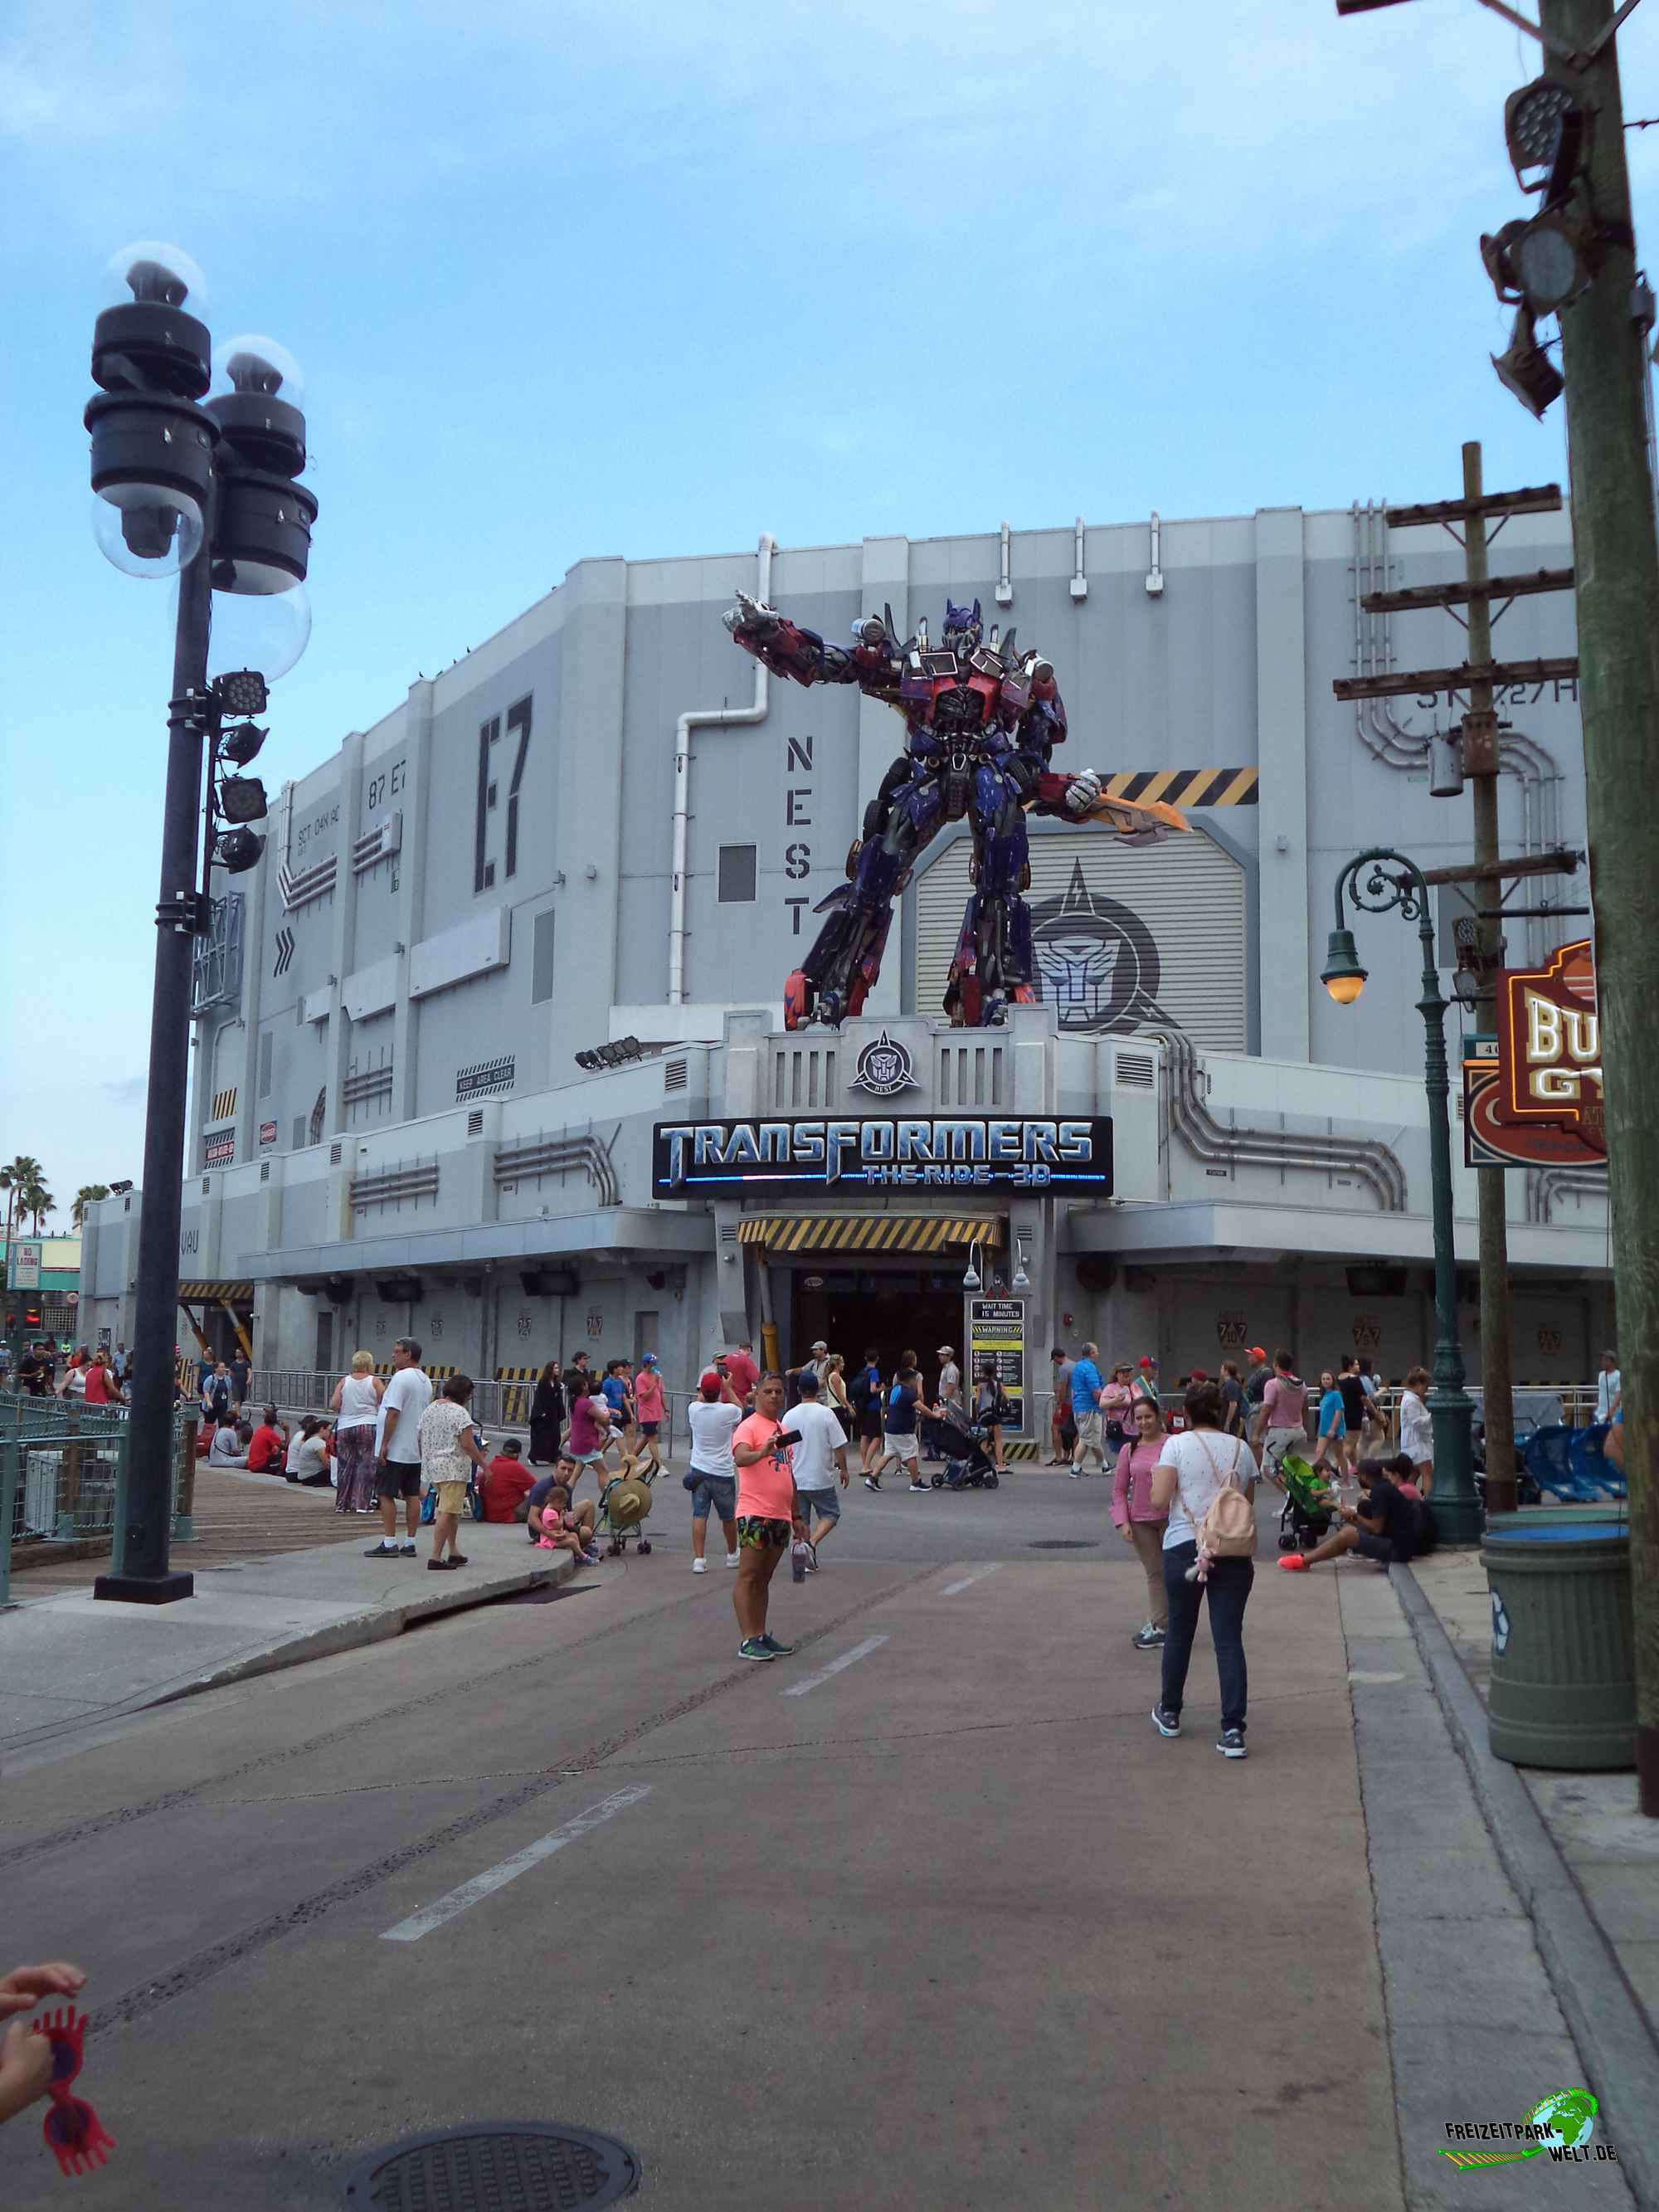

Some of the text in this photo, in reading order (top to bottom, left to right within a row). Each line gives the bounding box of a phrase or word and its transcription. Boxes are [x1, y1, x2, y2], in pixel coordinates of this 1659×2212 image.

[369, 774, 386, 810] 87
[474, 694, 533, 894] E7
[785, 737, 813, 934] NEST
[459, 1066, 512, 1090] KEEP AREA CLEAR
[659, 1120, 1093, 1189] TRANSFORMERS
[862, 1165, 918, 1186] THE
[923, 1164, 991, 1186] RIDE
[1013, 1163, 1051, 1187] 3D
